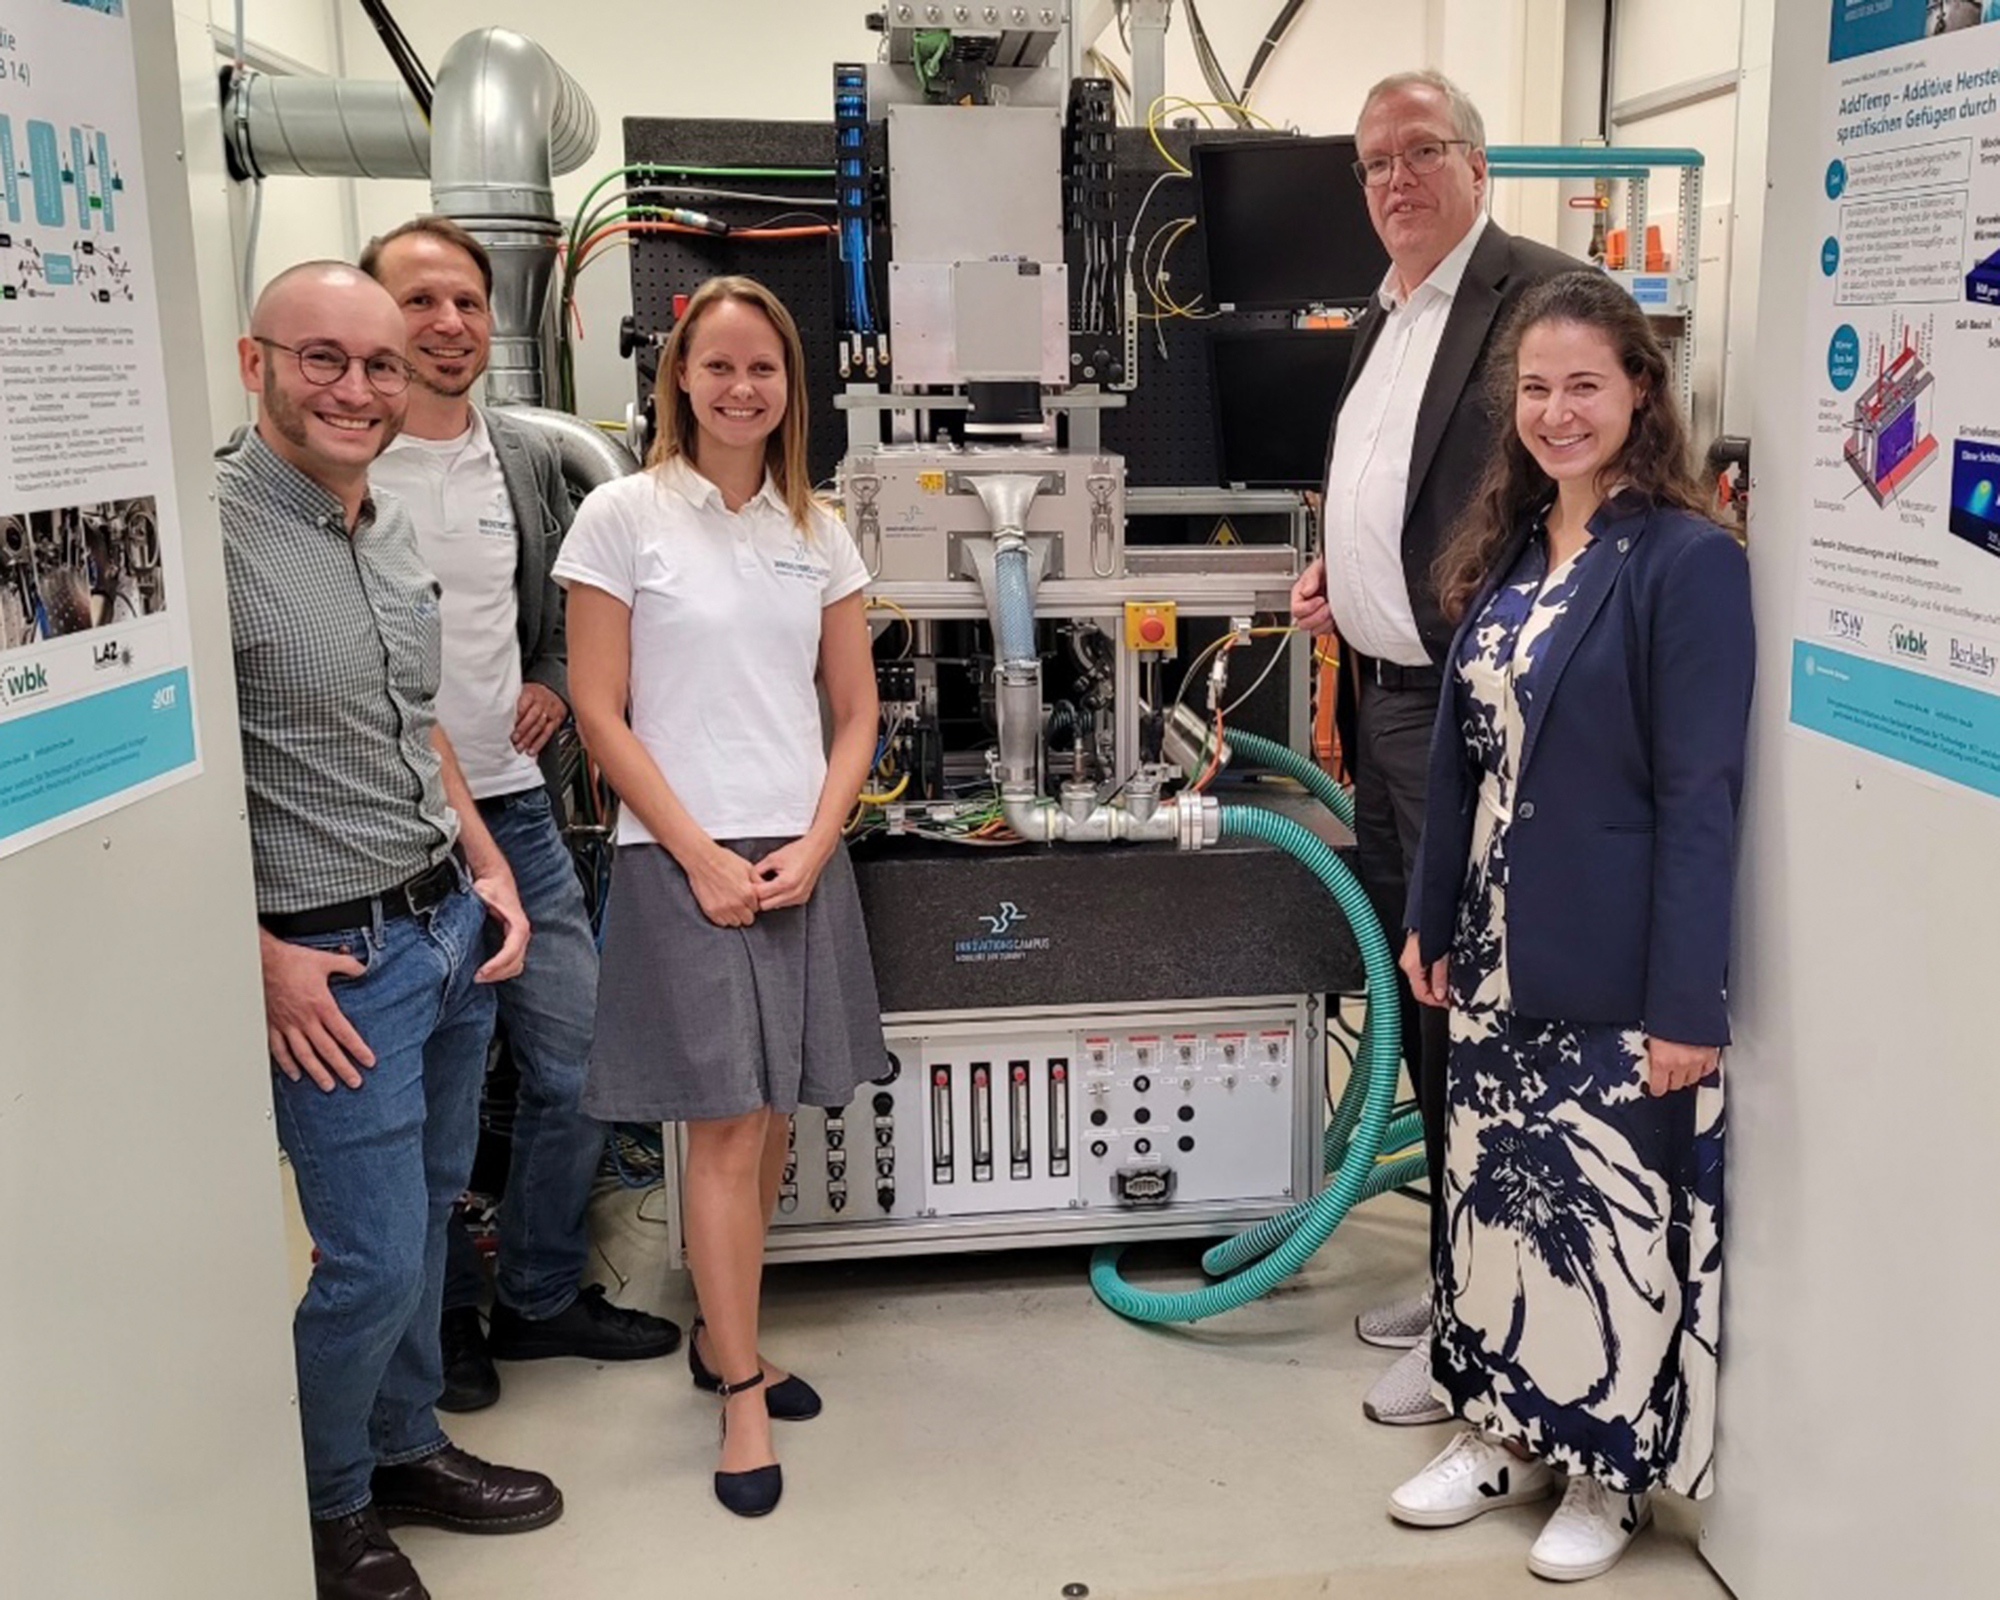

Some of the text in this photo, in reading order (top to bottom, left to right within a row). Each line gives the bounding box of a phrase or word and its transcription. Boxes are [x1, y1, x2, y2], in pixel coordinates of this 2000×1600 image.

[0, 28, 16, 51] ie
[1839, 93, 1891, 116] AddTemp
[1903, 77, 1952, 102] Additive
[1836, 92, 1997, 146] spezifischen Gefügen durch
[1828, 609, 1995, 677] IFSW wbk Berkeley
[7, 663, 48, 697] wbk
